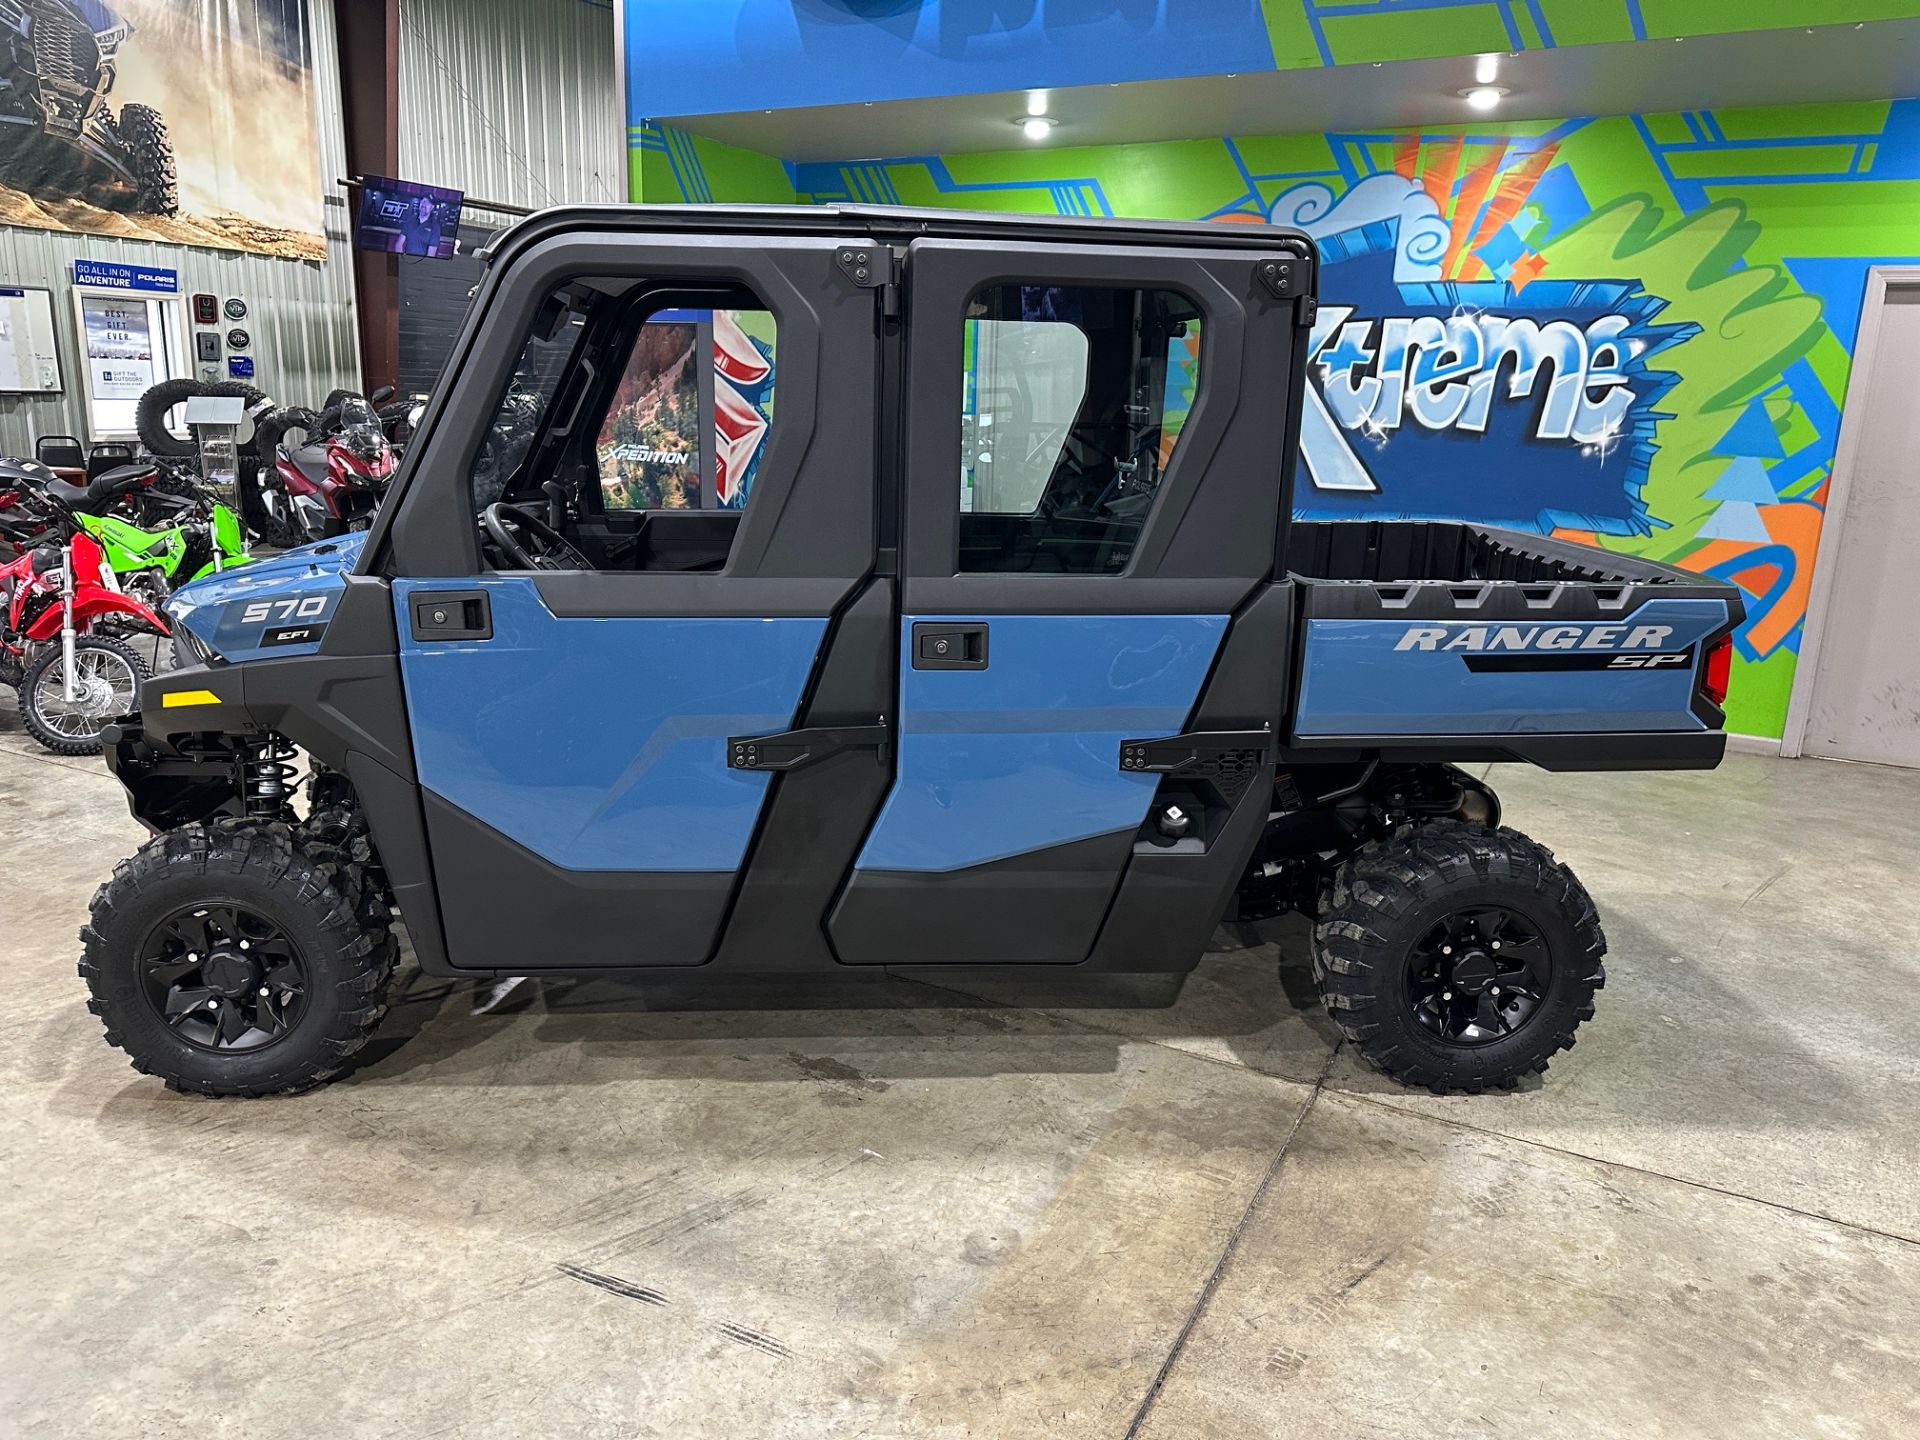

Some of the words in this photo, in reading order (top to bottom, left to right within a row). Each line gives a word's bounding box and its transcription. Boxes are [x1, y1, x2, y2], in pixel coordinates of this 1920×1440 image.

[78, 264, 89, 273] GO
[91, 266, 107, 275] ALL
[110, 267, 117, 277] IN
[119, 268, 130, 278] ON
[137, 273, 175, 283] POLARIS
[78, 274, 131, 287] ADVENTURE
[599, 443, 689, 465] XPEDITION
[103, 524, 125, 538] Kawasaki
[241, 596, 327, 623] 570
[277, 630, 309, 640] EFI
[1392, 625, 1673, 651] RANGER
[1607, 654, 1688, 668] SP
